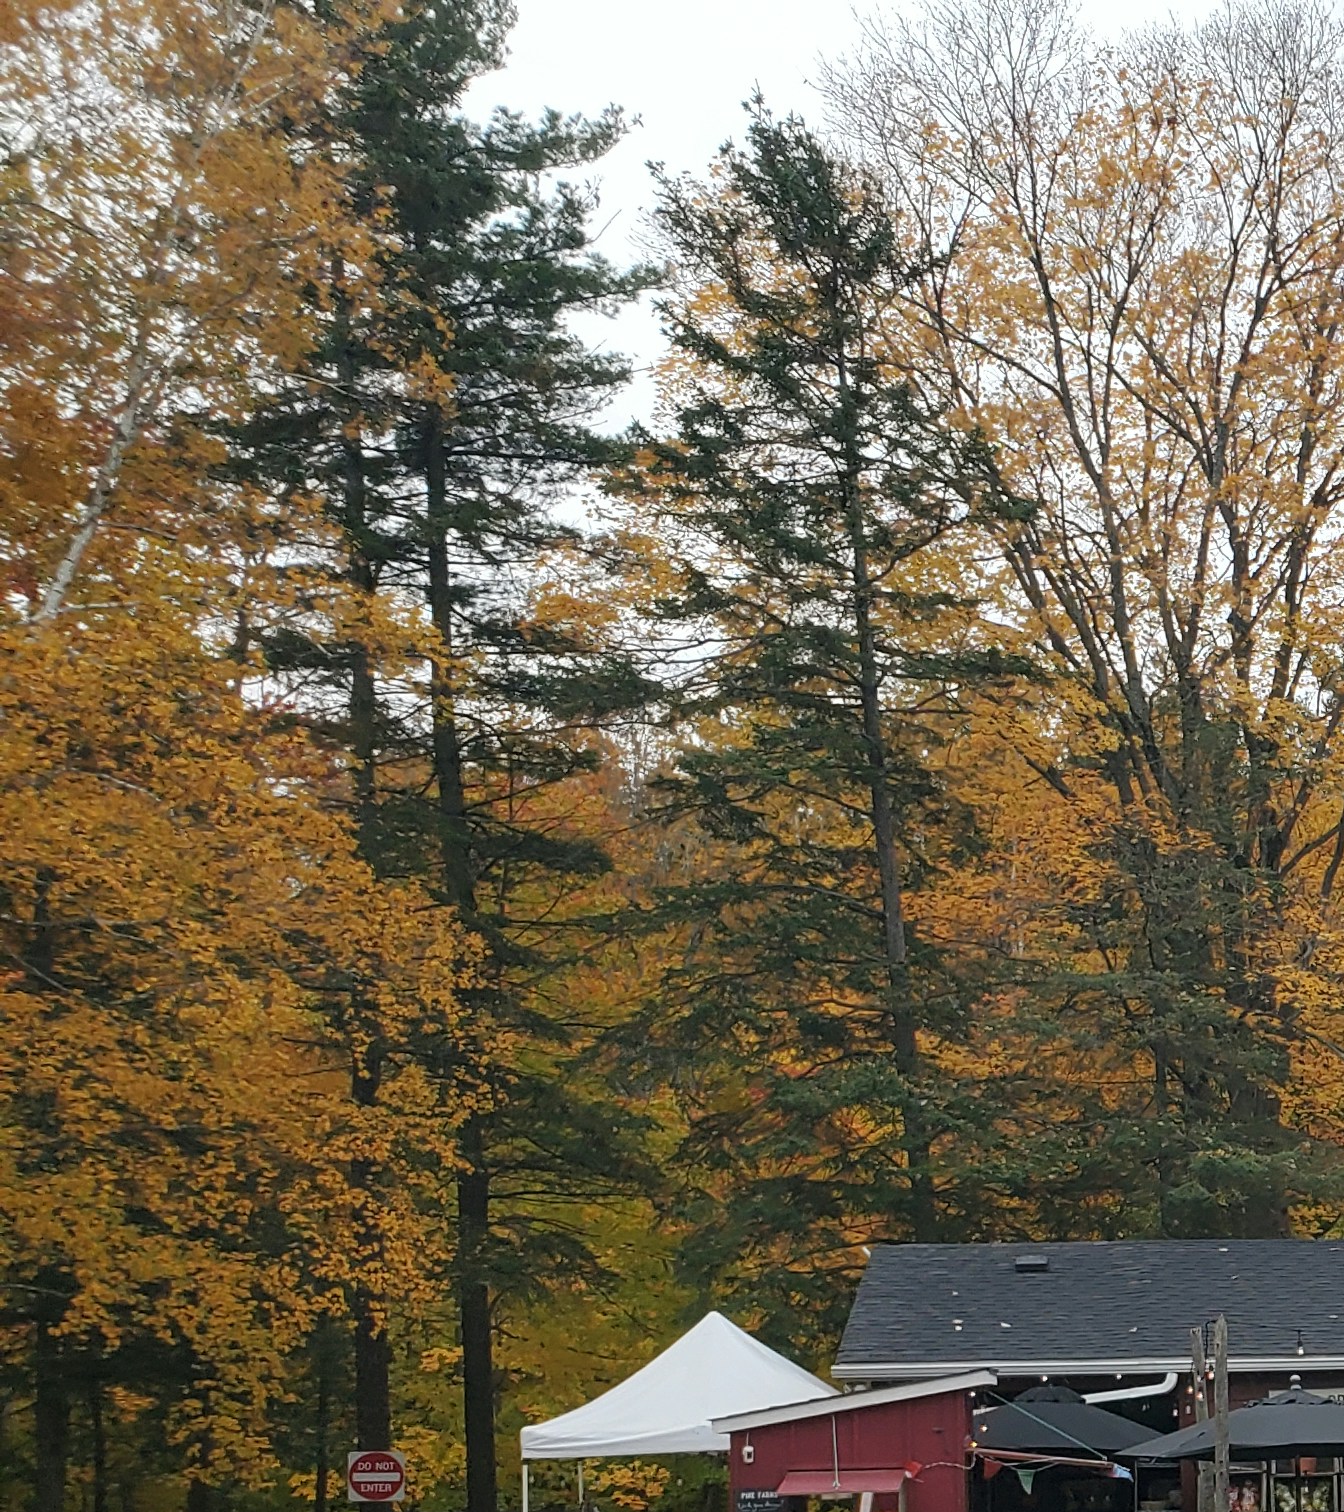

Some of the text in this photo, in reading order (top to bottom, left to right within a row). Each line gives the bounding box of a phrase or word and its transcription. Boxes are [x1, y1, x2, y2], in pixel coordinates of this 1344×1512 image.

[357, 1461, 396, 1471] DO NOT
[360, 1483, 392, 1493] ENTER
